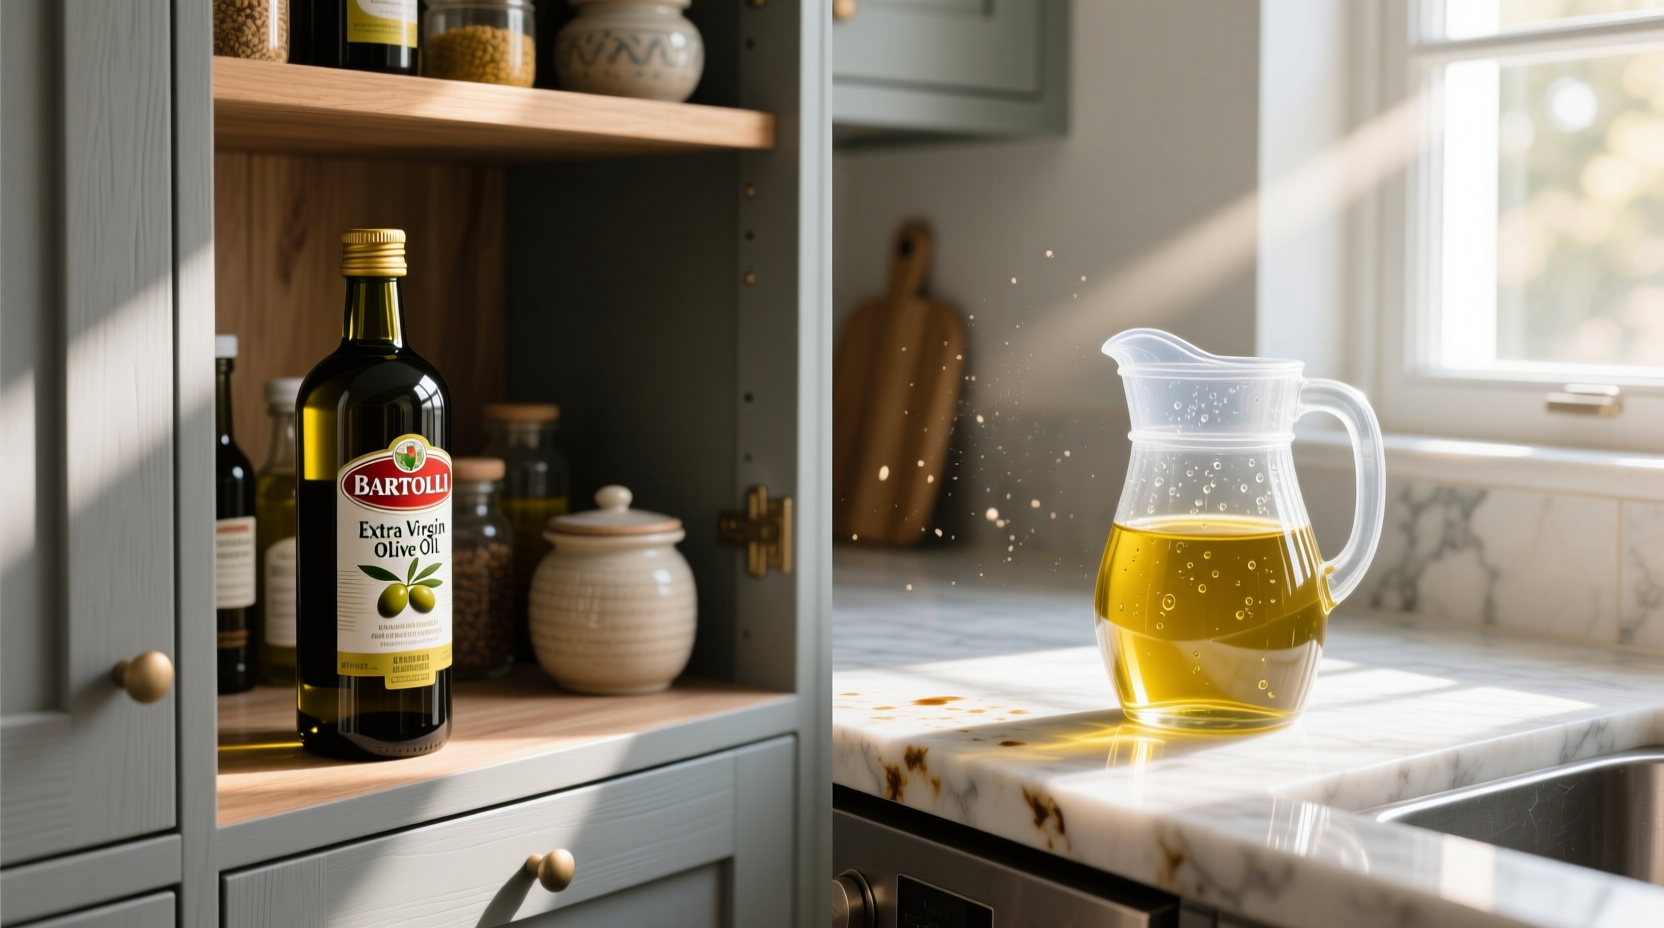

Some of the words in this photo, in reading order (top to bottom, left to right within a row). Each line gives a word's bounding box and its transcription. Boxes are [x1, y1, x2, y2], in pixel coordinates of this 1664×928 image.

[354, 473, 448, 496] BARTOLLI
[359, 521, 402, 539] Extra
[406, 518, 445, 539] Virgin
[374, 541, 416, 558] Olive
